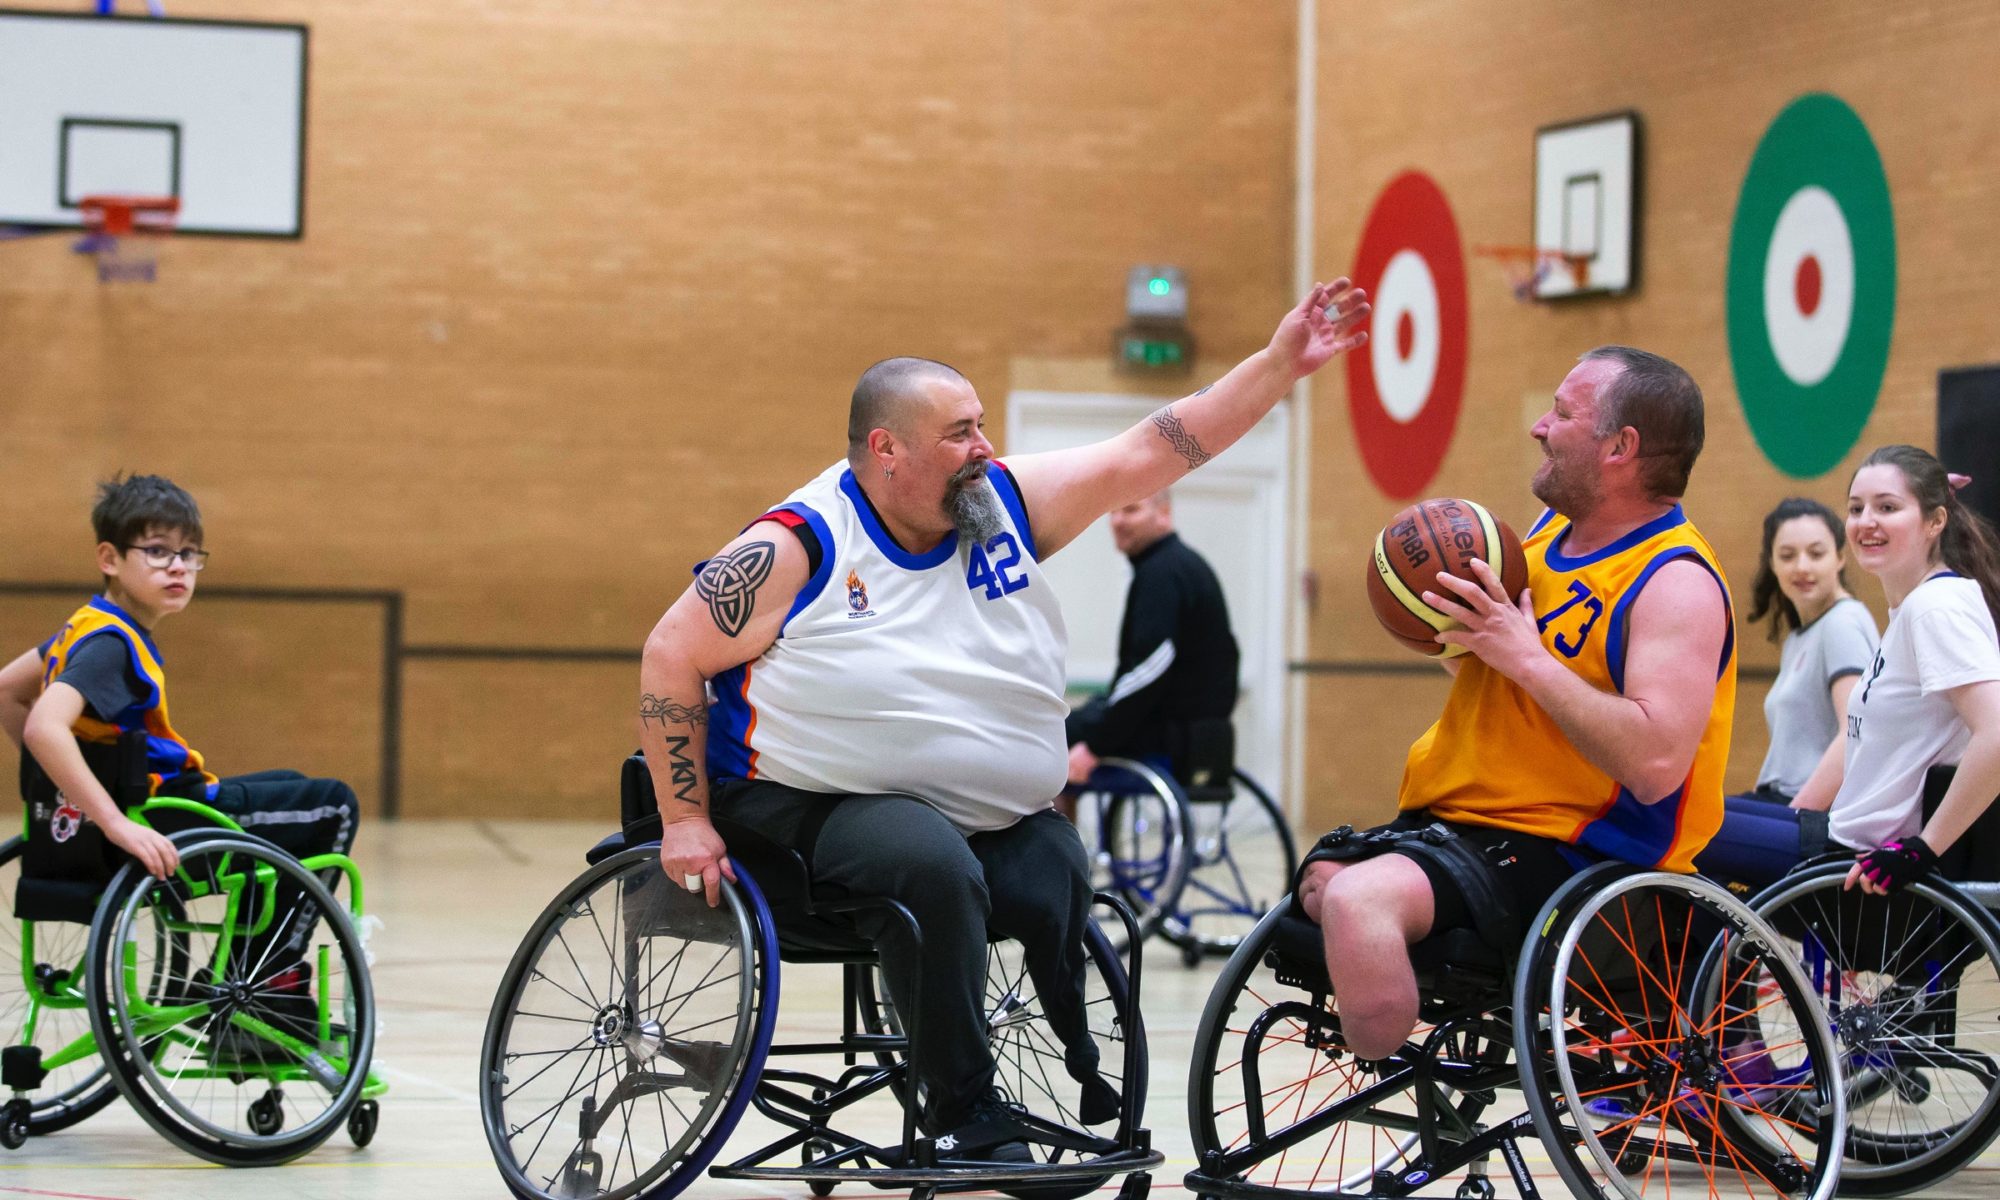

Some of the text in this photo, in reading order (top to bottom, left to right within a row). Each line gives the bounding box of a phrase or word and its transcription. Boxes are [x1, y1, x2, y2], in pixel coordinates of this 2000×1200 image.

[1398, 524, 1430, 569] FIBA
[1429, 506, 1452, 550] OFFICIAL
[967, 531, 1029, 601] 42
[1536, 579, 1603, 659] 73
[1688, 890, 1778, 959] INERGY
